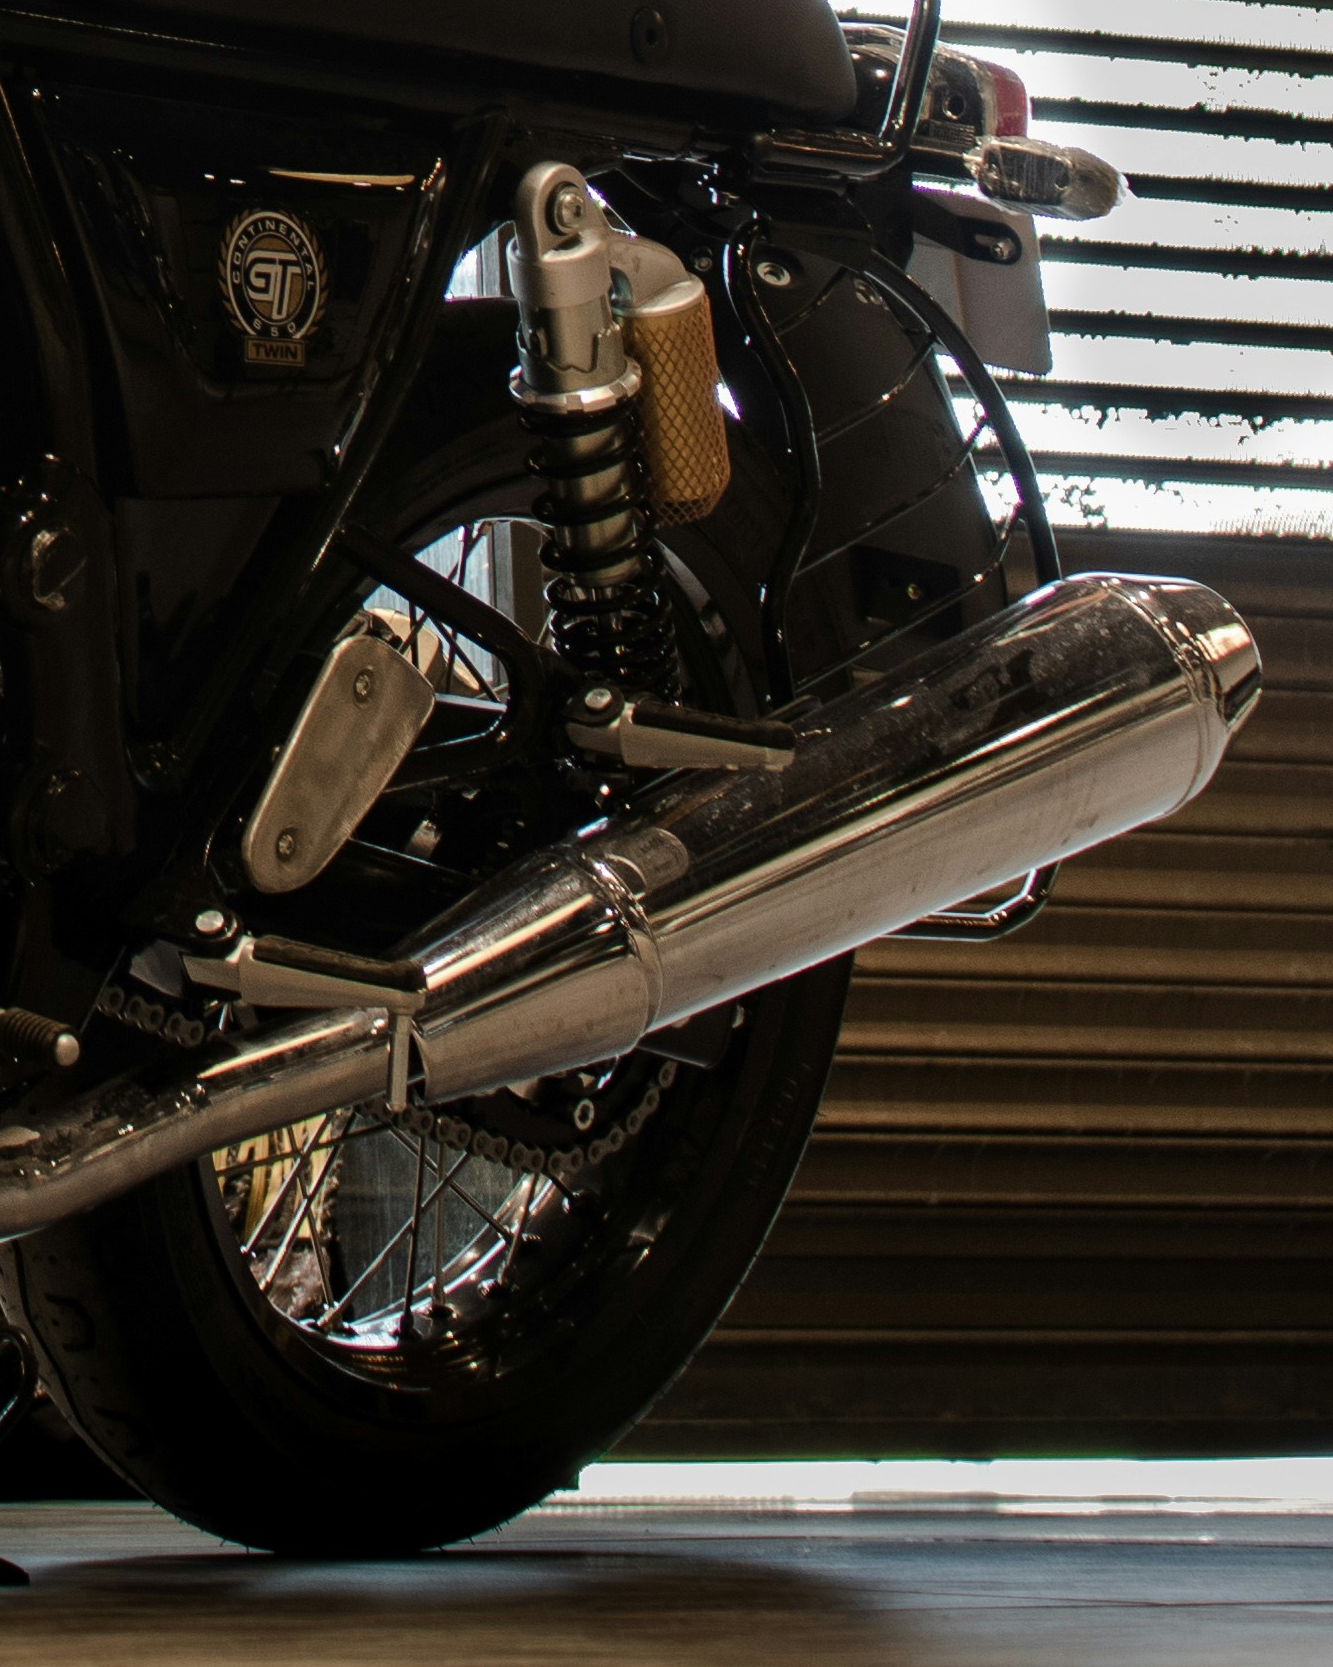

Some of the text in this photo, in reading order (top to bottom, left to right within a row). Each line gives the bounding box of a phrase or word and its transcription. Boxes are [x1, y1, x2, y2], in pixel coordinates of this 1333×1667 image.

[233, 219, 316, 291] CONTINENTAL
[246, 249, 302, 320] GT
[253, 342, 298, 360] TWIN
